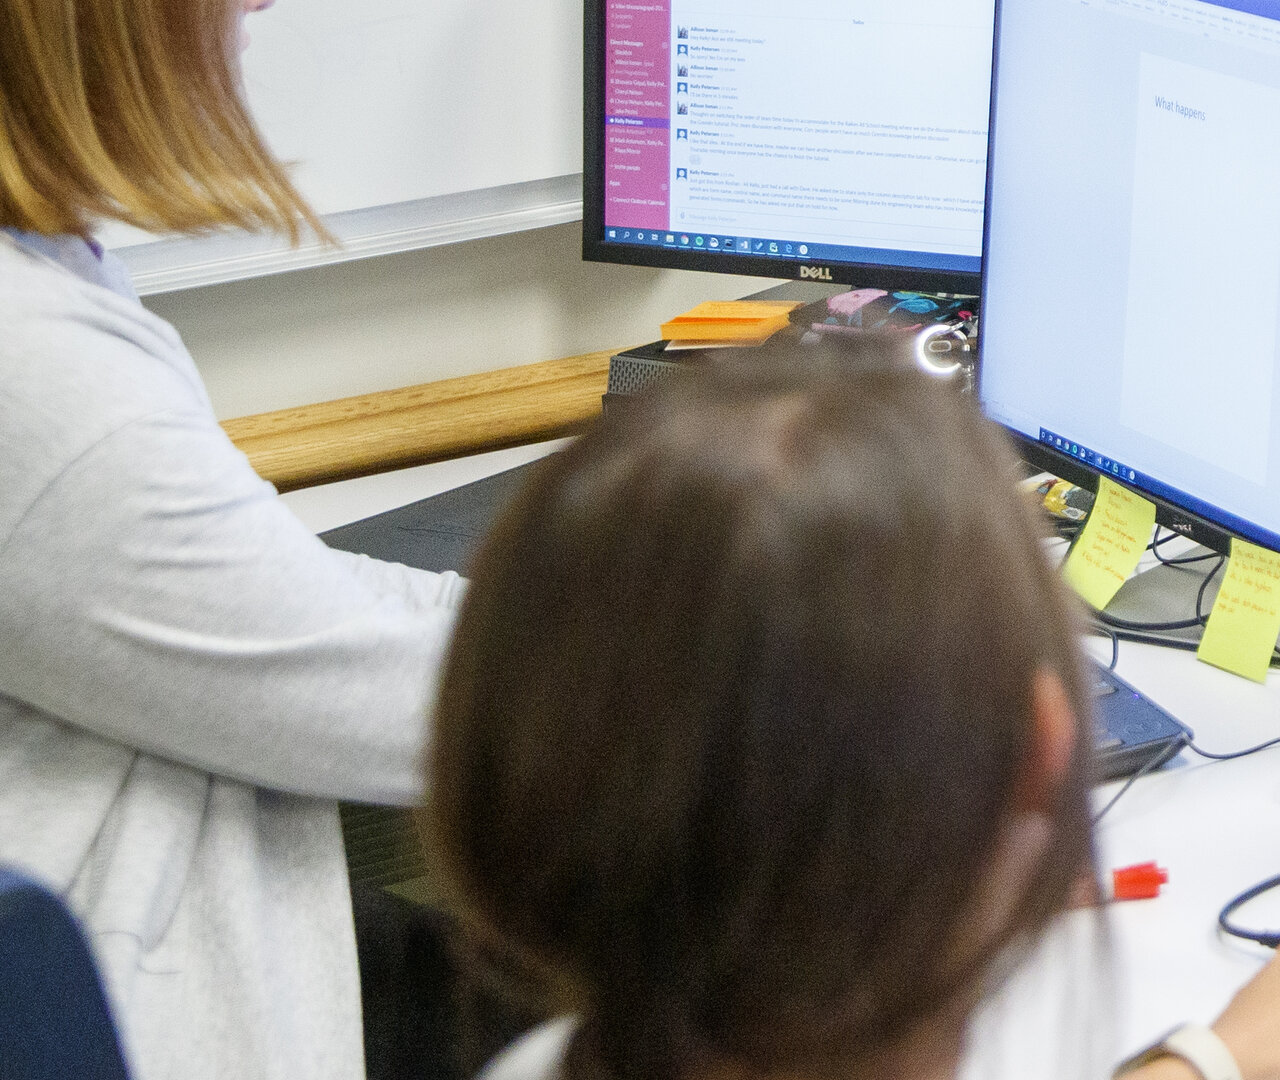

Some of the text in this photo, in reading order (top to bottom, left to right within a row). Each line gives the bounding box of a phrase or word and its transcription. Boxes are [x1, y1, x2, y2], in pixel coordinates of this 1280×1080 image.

[1154, 94, 1206, 121] What happens
[799, 265, 833, 281] DELL
